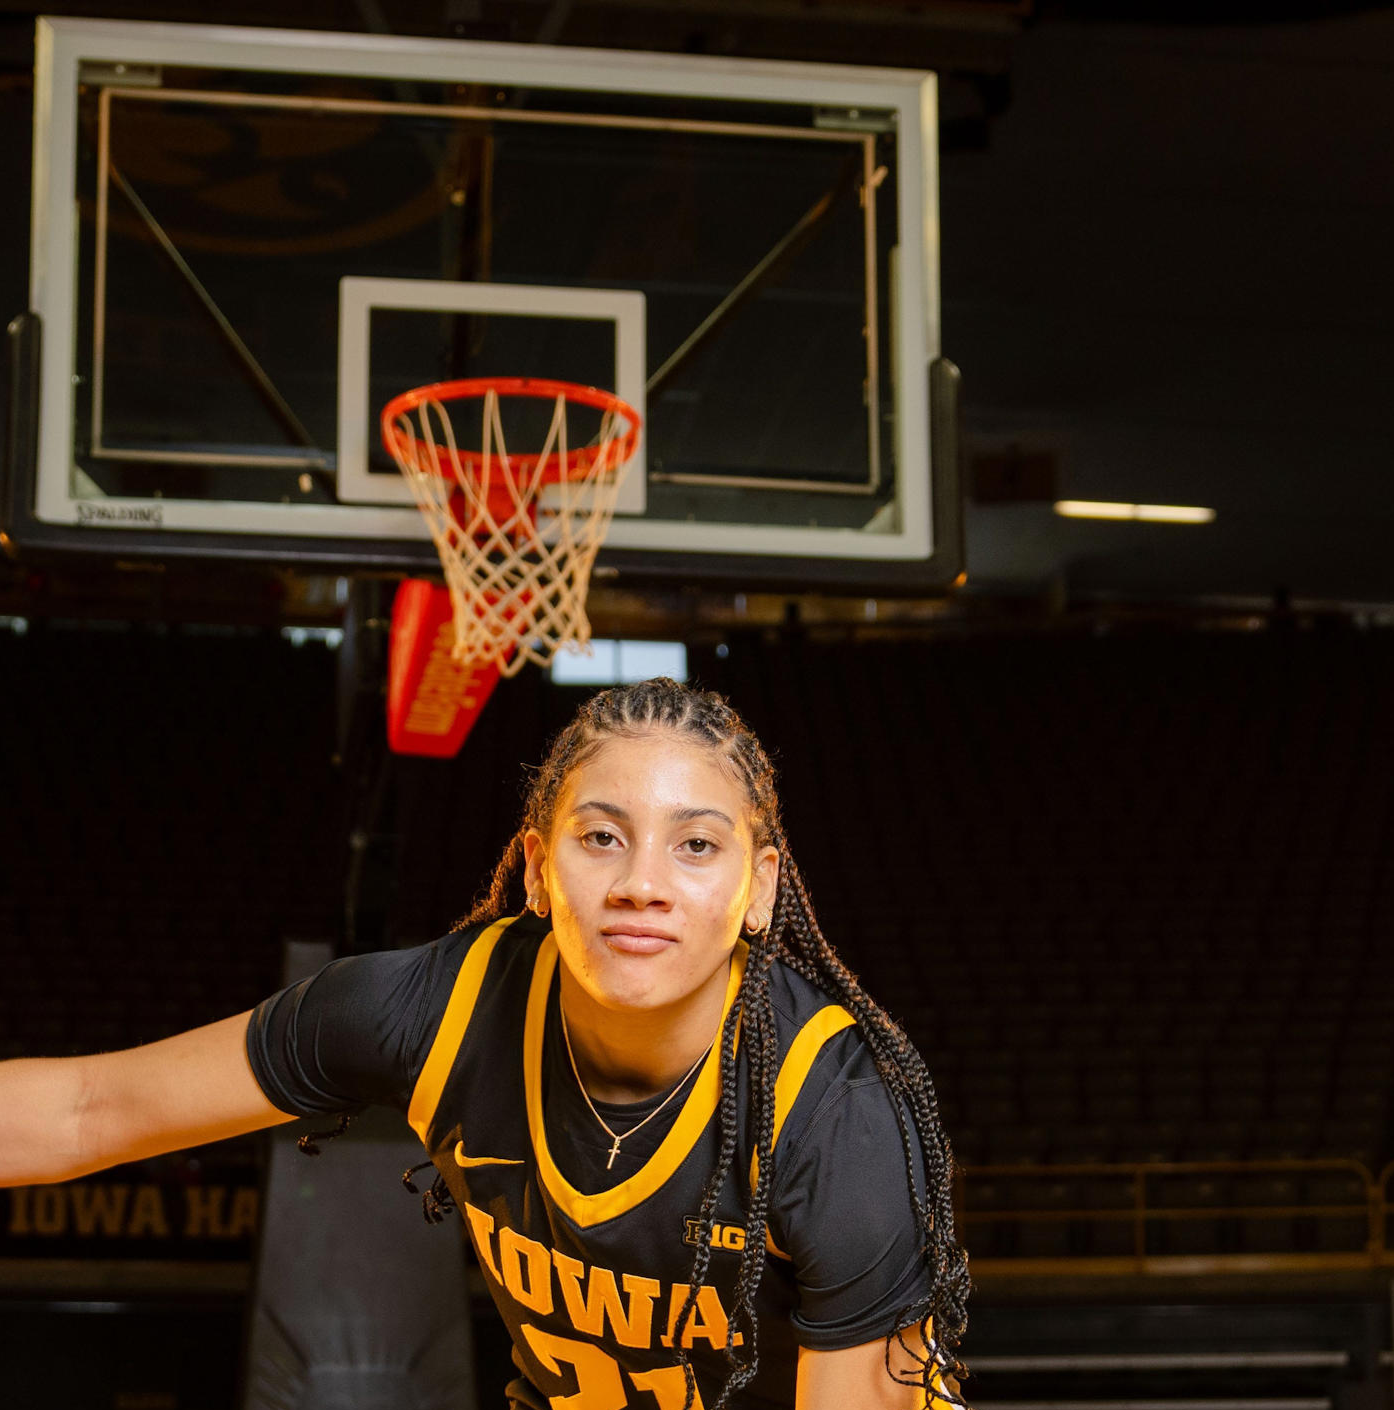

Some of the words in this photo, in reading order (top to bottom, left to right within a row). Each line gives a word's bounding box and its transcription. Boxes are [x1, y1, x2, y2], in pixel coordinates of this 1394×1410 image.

[77, 504, 163, 528] SPALDING
[7, 1183, 169, 1238] IOWA
[464, 1202, 744, 1350] IOWA
